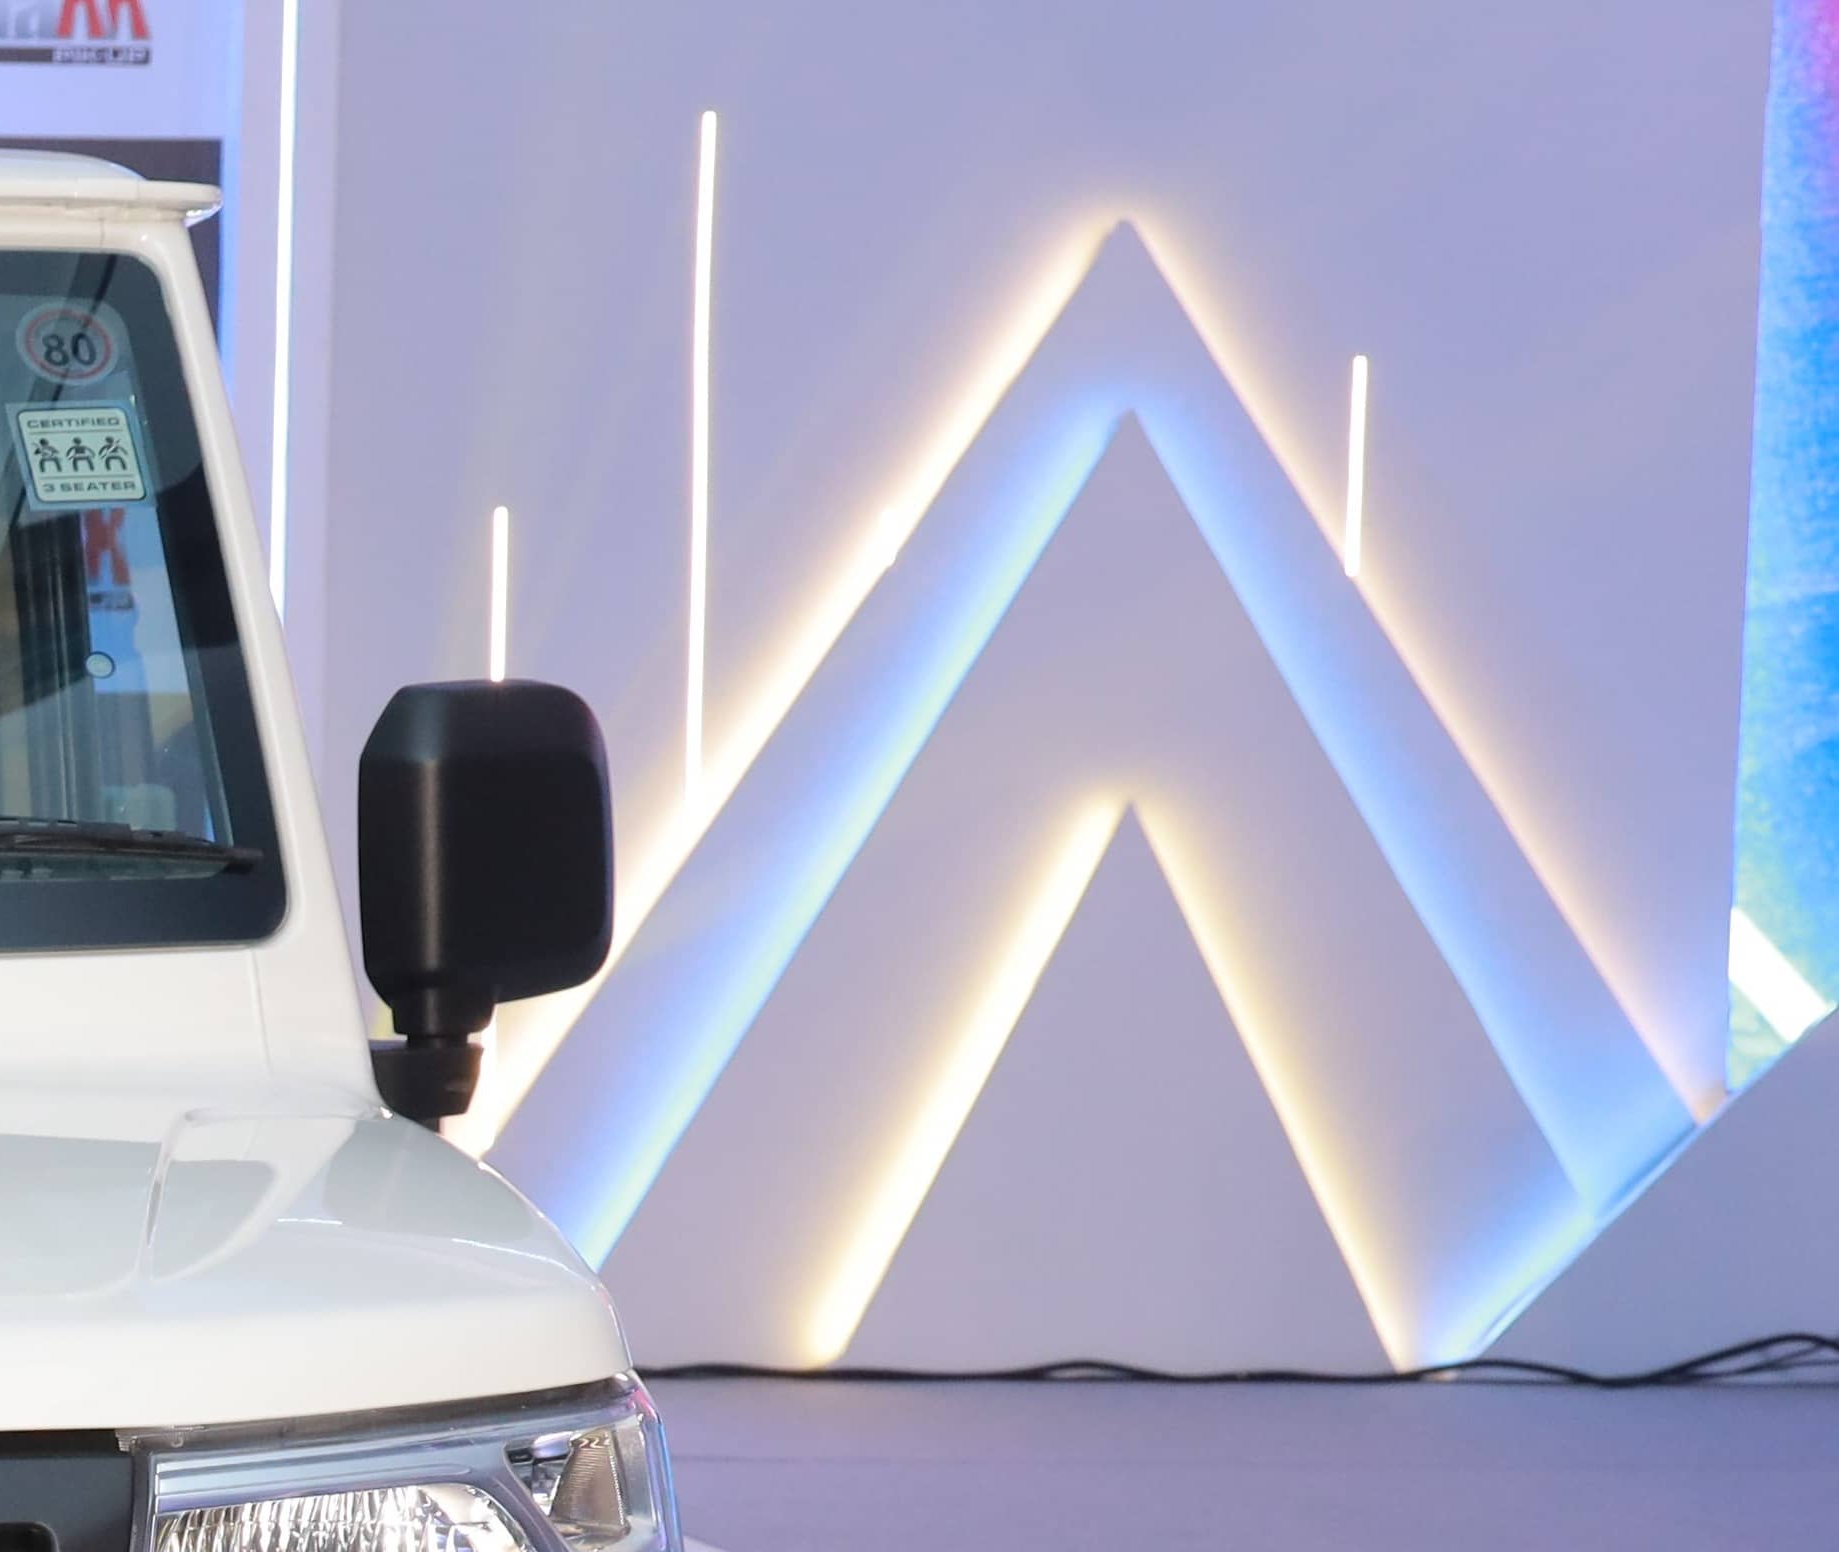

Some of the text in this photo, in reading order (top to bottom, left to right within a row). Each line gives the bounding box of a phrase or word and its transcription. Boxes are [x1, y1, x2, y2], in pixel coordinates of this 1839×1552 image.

[42, 332, 97, 367] 80
[26, 416, 121, 429] CERTIFIED
[42, 480, 137, 493] 3 SEATER
